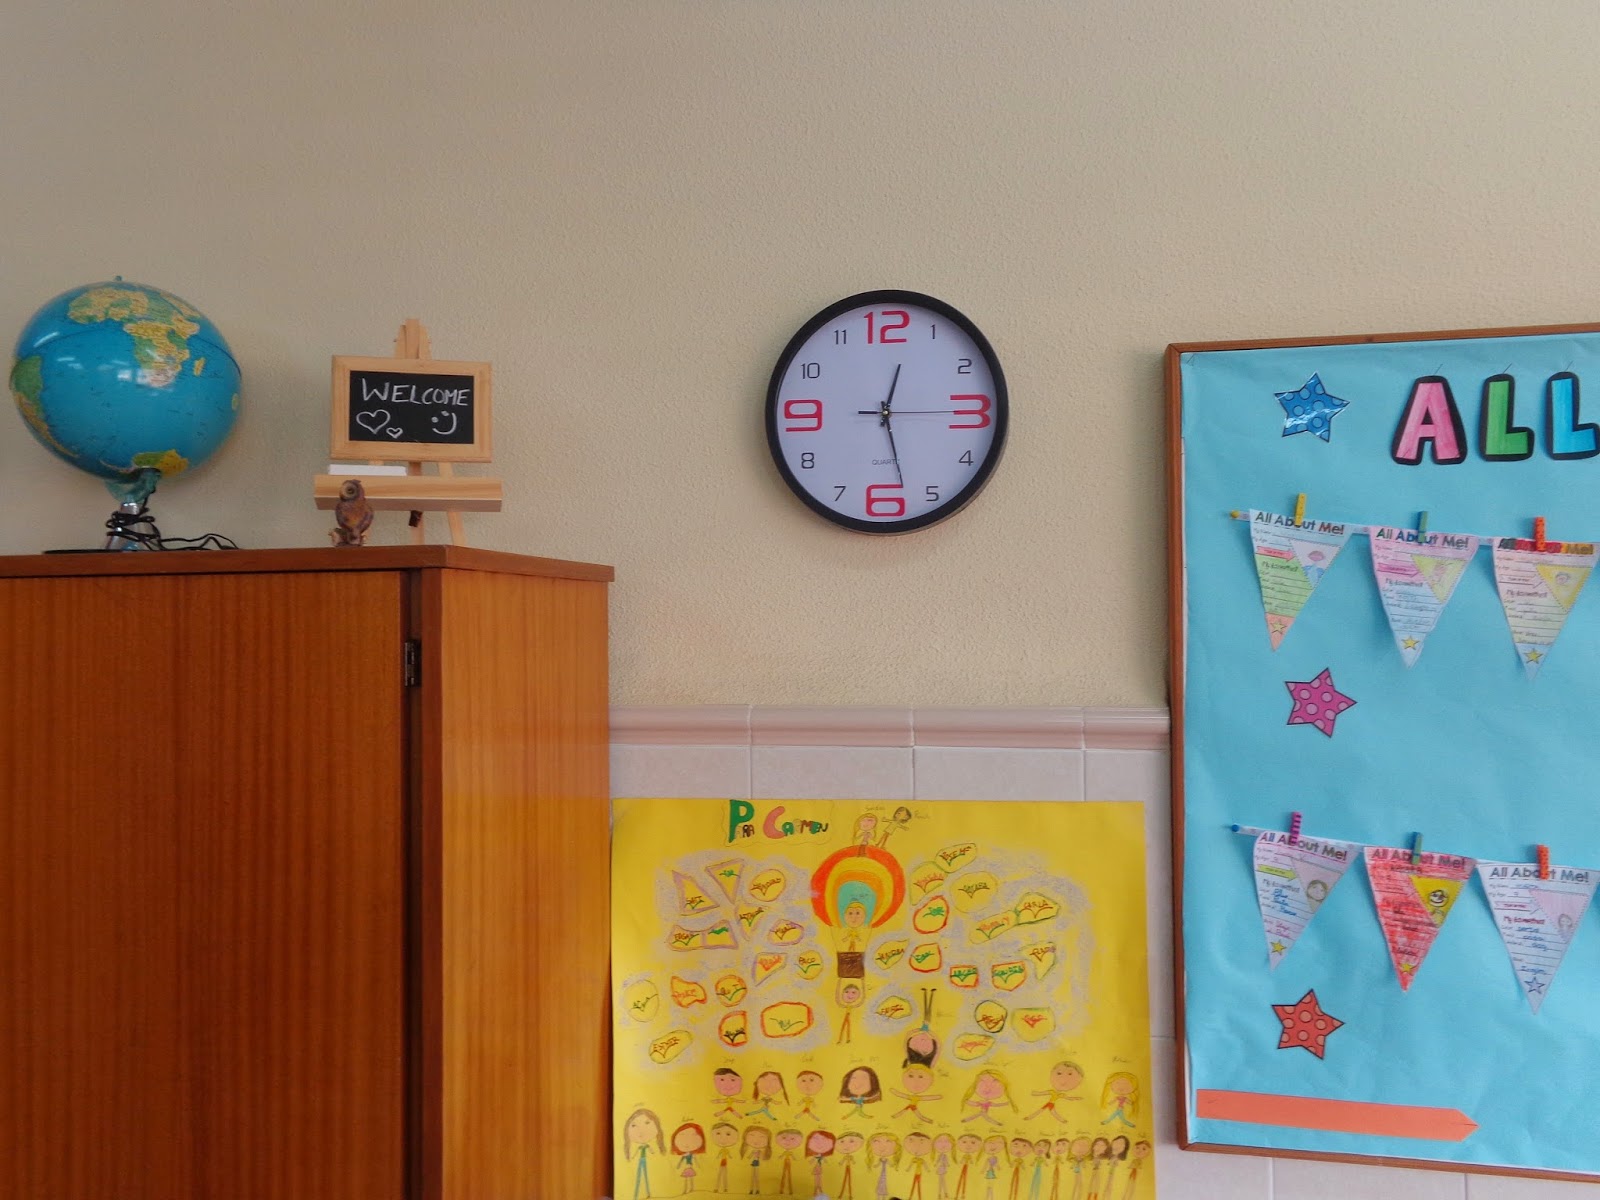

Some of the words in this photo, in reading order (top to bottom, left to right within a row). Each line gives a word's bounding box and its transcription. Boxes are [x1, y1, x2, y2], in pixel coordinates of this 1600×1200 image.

[834, 329, 847, 344] 11
[864, 310, 910, 344] 12
[930, 324, 936, 340] 1
[801, 362, 821, 379] 10
[957, 358, 972, 374] 2
[362, 378, 470, 406] WELCOME
[784, 399, 822, 432] 9
[949, 394, 991, 429] 3
[1391, 371, 1600, 465] ALL
[801, 452, 815, 469] 8
[958, 450, 974, 466] 4
[834, 485, 846, 501] 7
[866, 484, 905, 517] 6
[926, 486, 939, 501] 5
[1256, 511, 1273, 523] All
[1318, 521, 1345, 535] Me!
[1376, 528, 1394, 540] All
[1441, 535, 1470, 548] Me!
[1261, 832, 1276, 843] All
[1321, 845, 1348, 861] Me!
[1372, 848, 1389, 859] All
[1391, 849, 1434, 862] Abut
[1438, 855, 1465, 869] Me!
[1490, 867, 1508, 877] All
[1510, 867, 1557, 880] Abot
[1561, 870, 1590, 883] Me!
